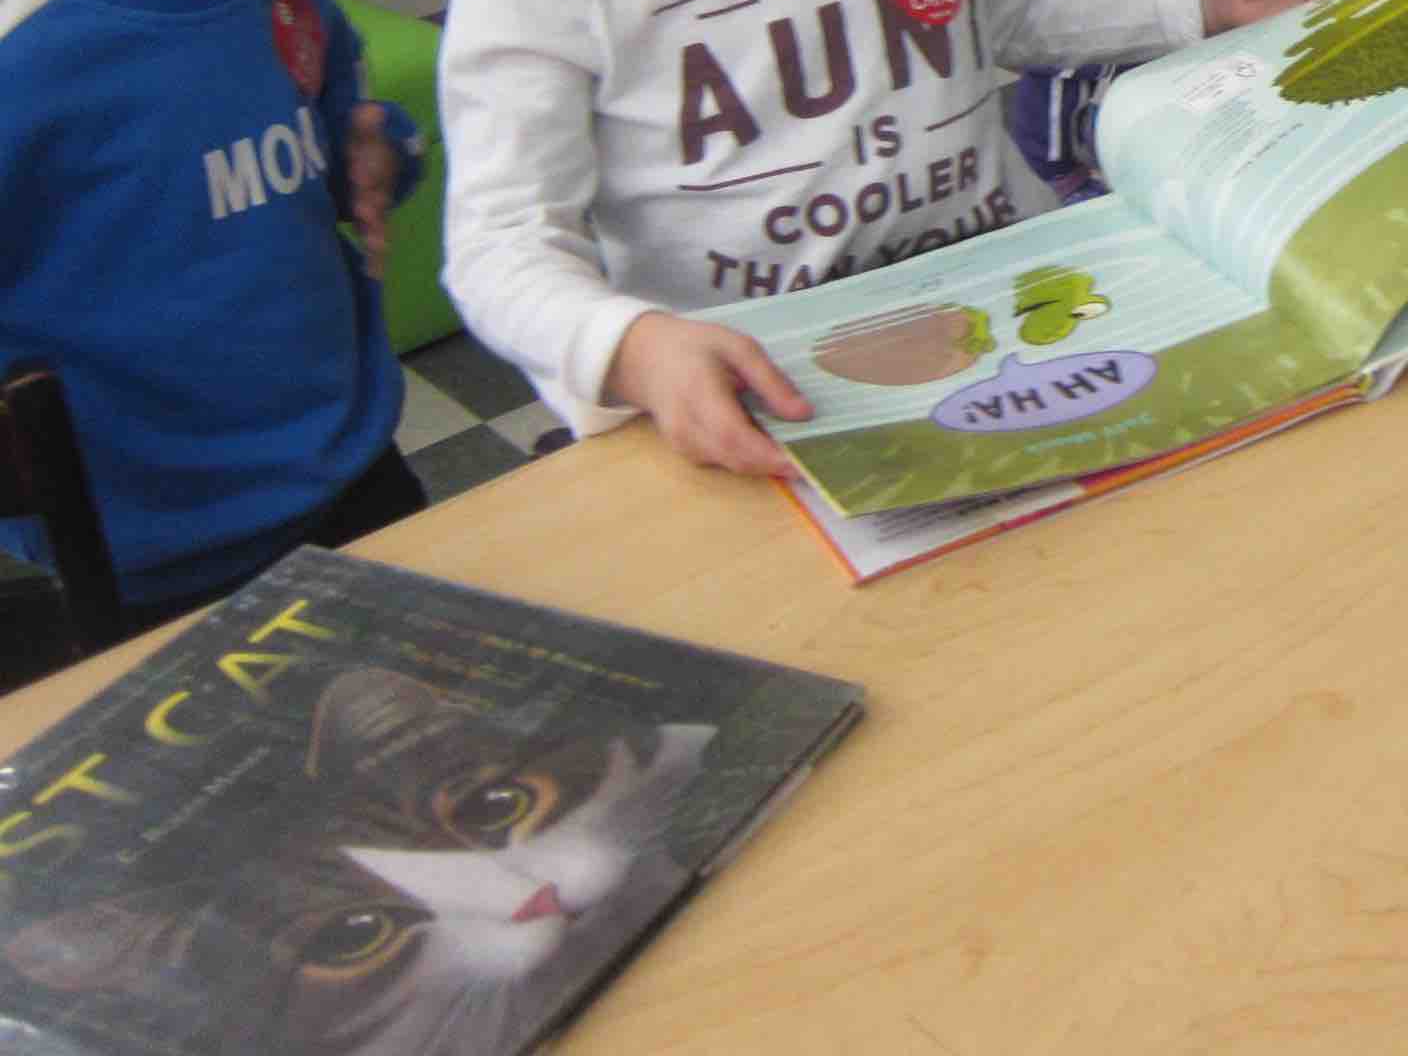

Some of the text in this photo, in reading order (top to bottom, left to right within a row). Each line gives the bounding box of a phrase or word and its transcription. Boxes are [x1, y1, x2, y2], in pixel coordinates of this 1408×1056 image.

[853, 114, 901, 165] IS
[765, 146, 980, 245] COOLER
[144, 598, 338, 745] CAT
